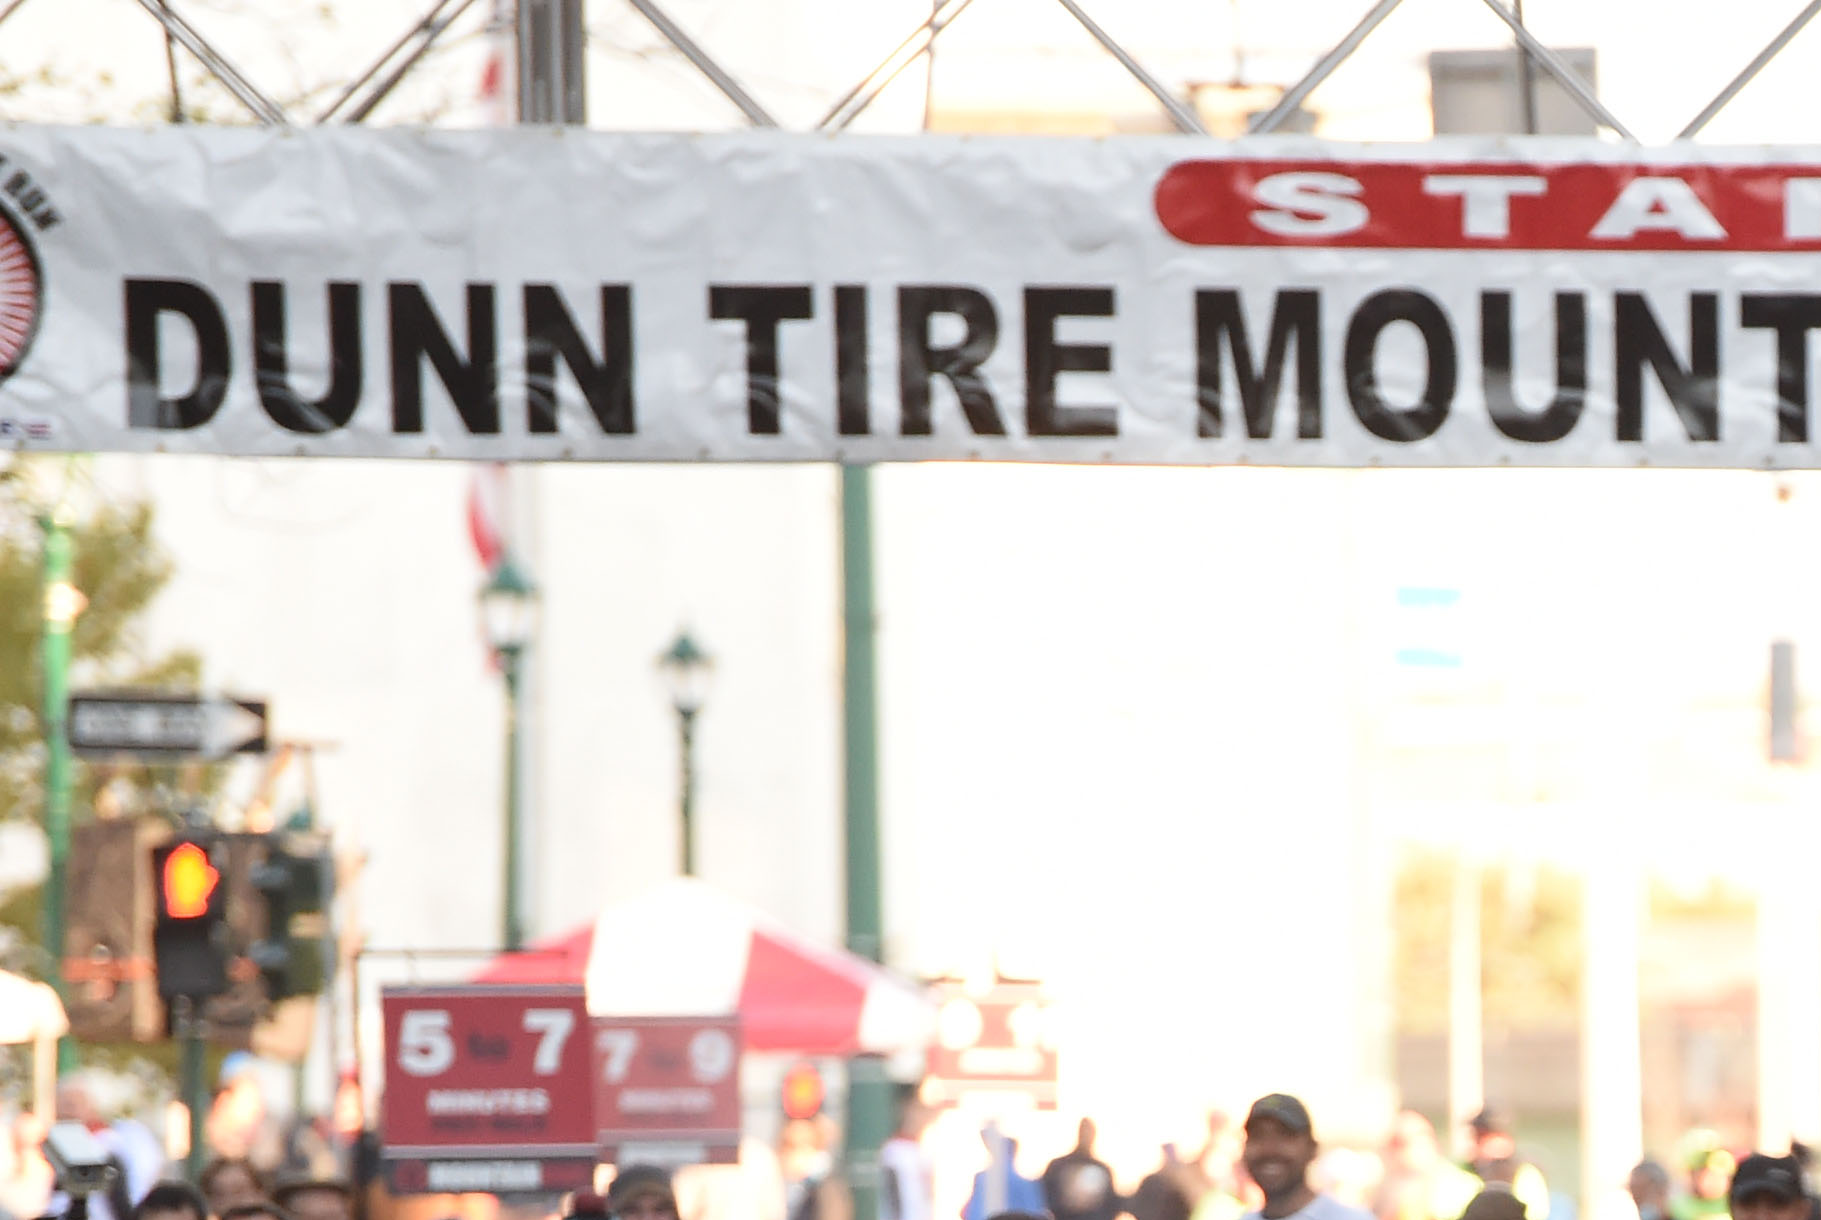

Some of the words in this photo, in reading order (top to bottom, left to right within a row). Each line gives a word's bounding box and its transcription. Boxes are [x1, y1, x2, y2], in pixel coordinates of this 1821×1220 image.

[123, 277, 637, 436] DUNN
[708, 282, 1121, 438] TIRE
[399, 1009, 456, 1077] 5
[522, 1008, 575, 1076] 7
[597, 1029, 640, 1085] 7
